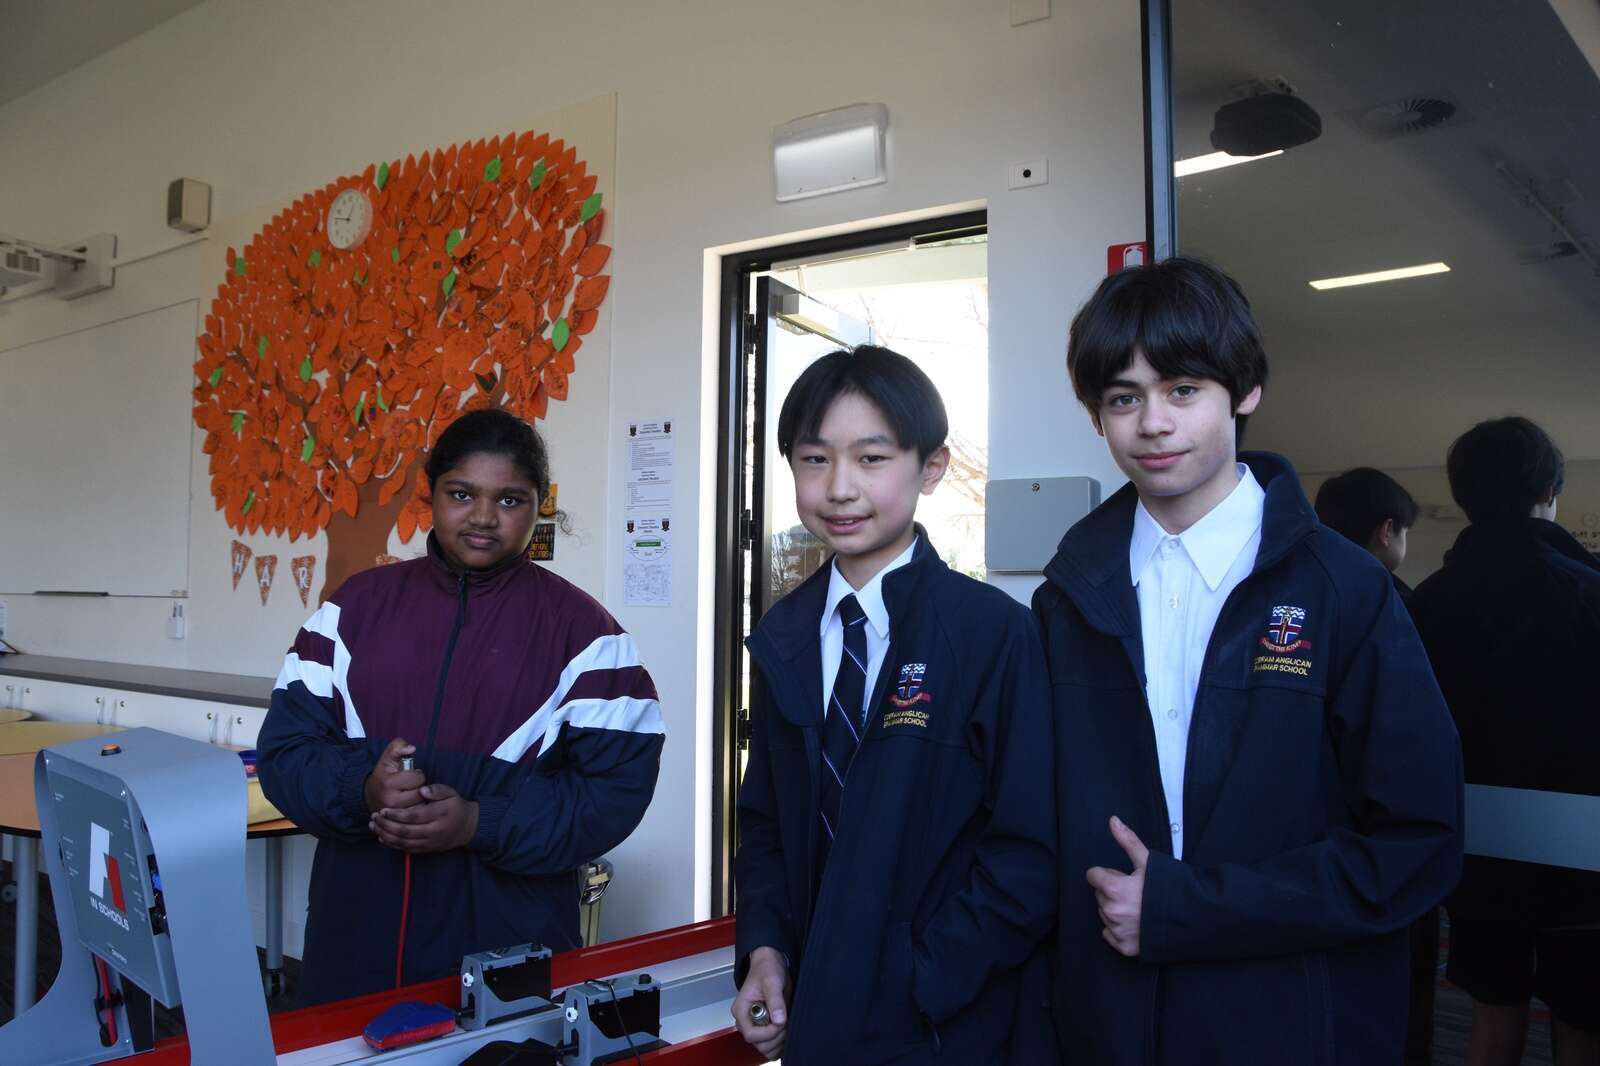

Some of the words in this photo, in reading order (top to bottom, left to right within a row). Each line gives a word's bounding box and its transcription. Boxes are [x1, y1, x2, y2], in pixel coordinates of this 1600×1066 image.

[1275, 657, 1312, 668] ANGLICAN
[1279, 665, 1308, 676] SCHOOL
[904, 717, 927, 728] SCHOOL
[98, 901, 130, 932] SCHOOLS
